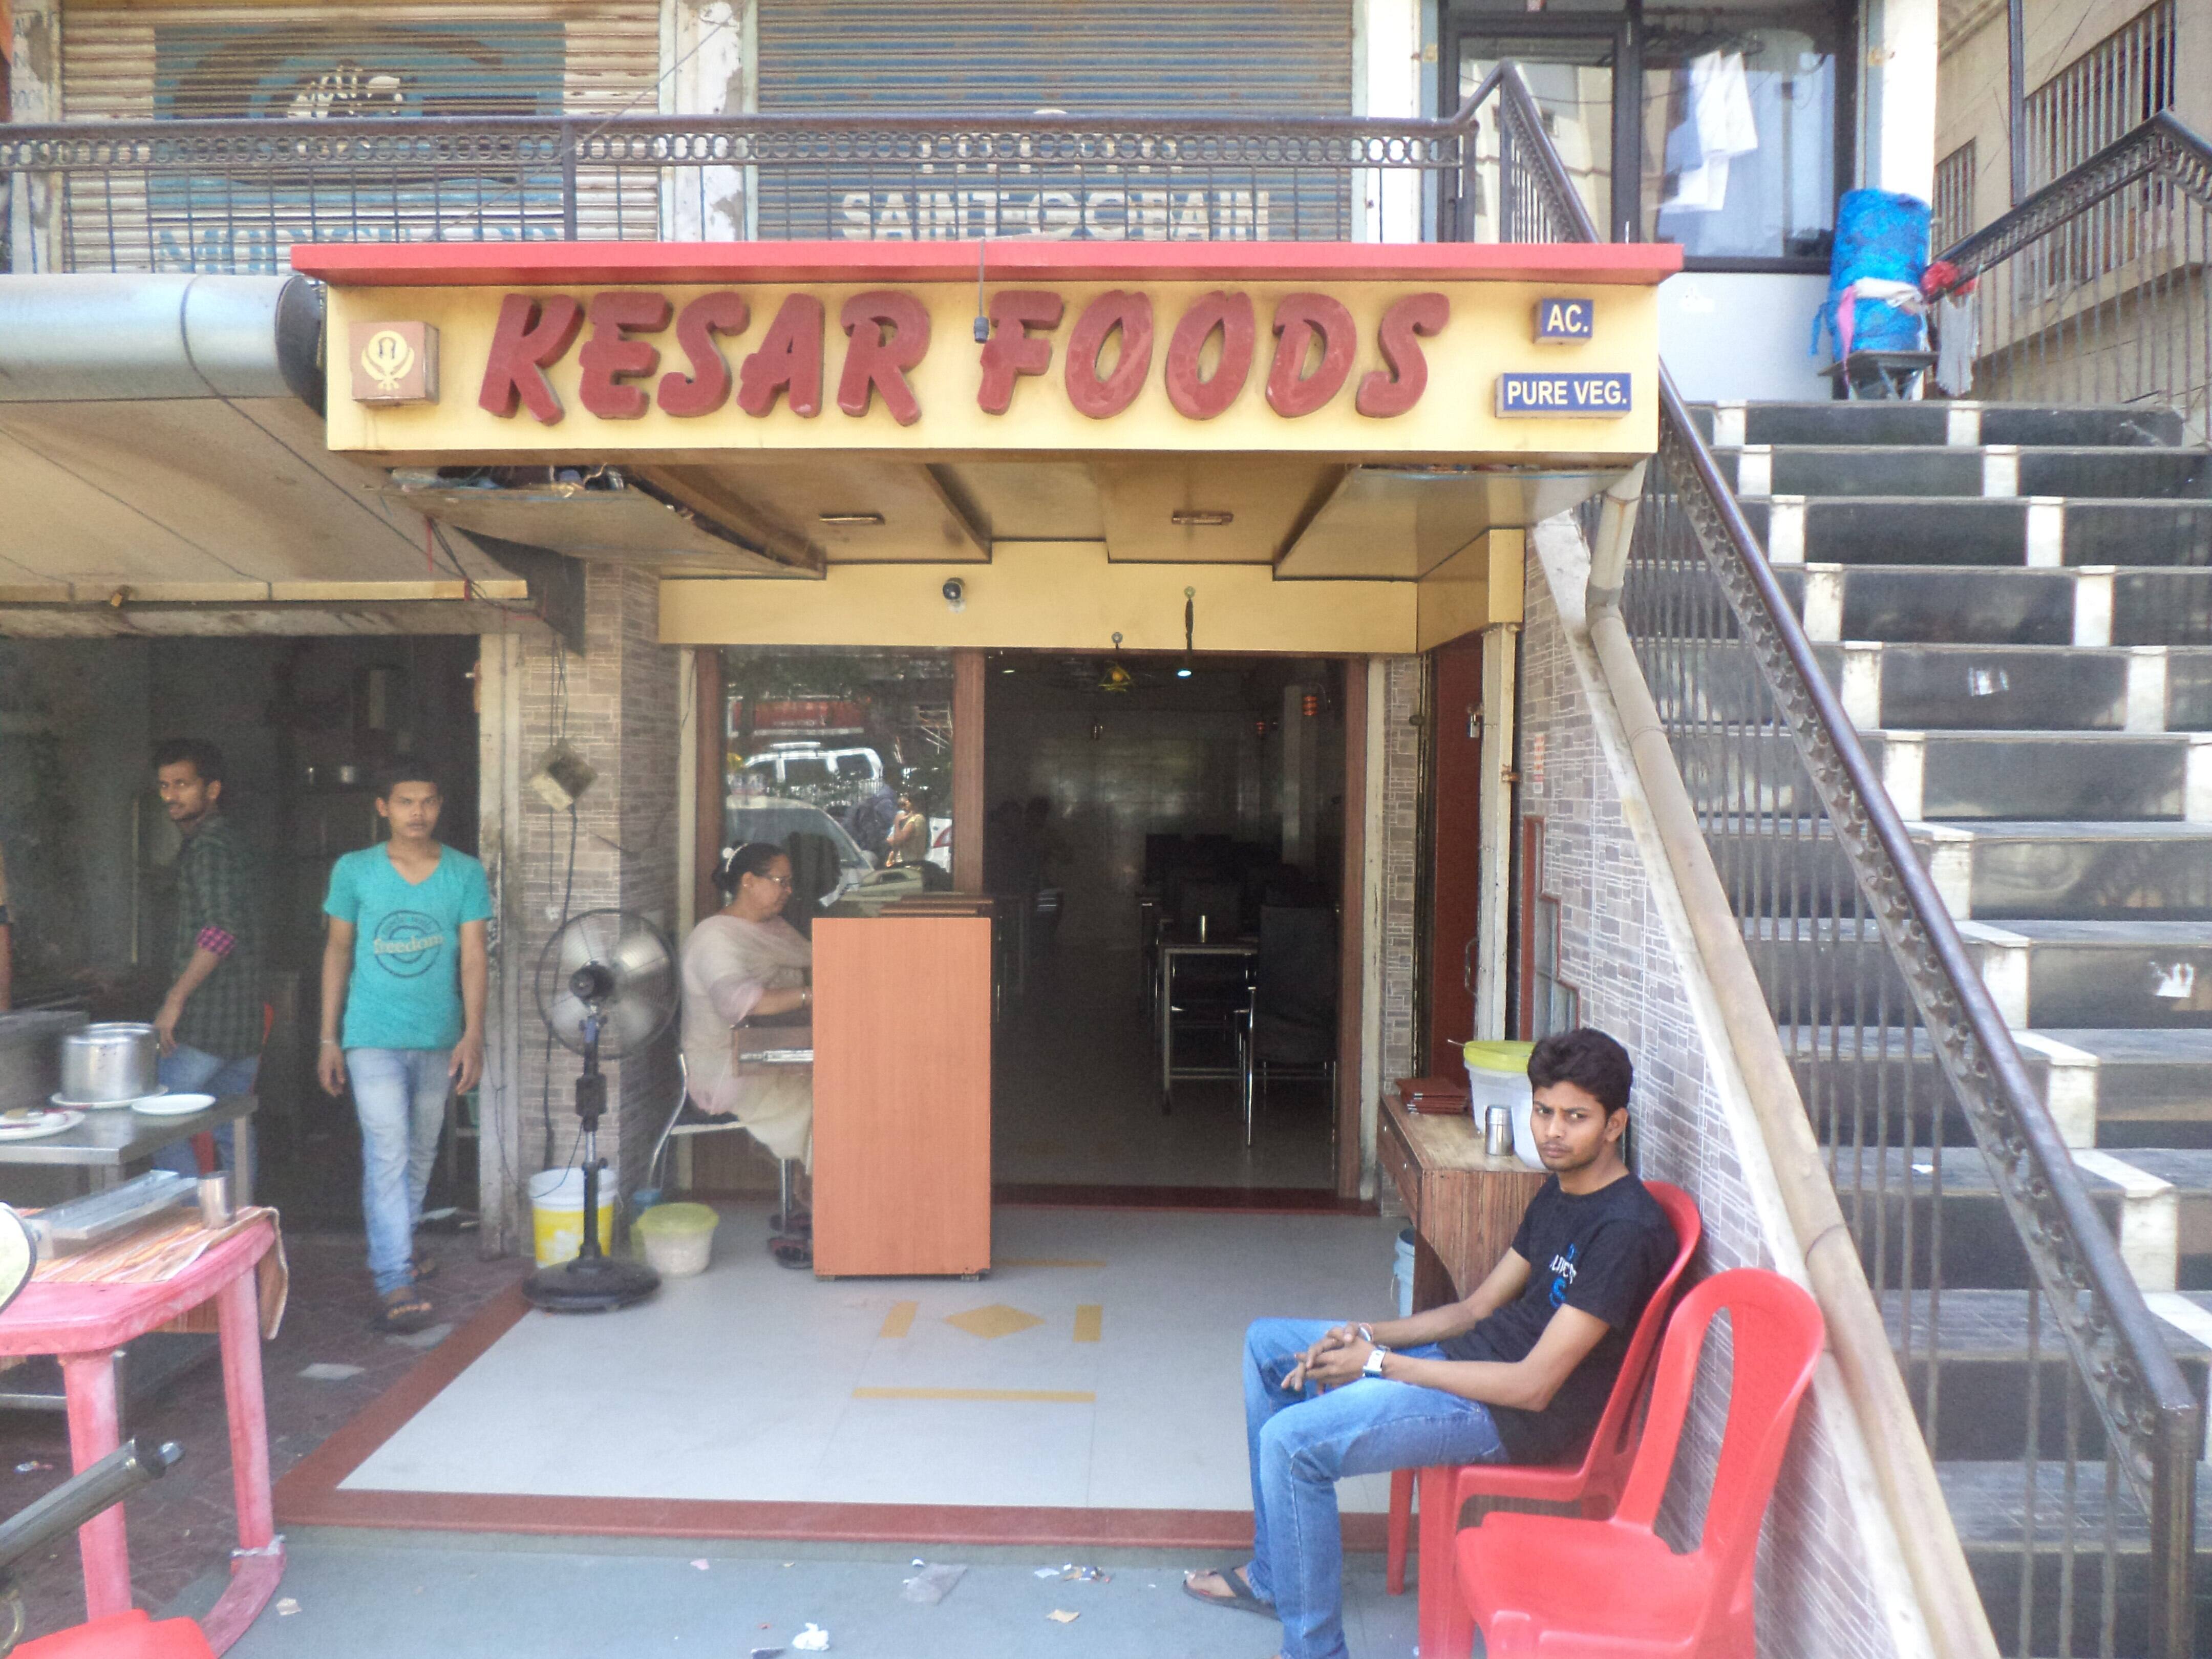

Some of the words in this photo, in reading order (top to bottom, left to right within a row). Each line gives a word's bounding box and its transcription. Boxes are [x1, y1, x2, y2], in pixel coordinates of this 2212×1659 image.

[478, 290, 931, 427] KESAR
[976, 289, 1450, 420] FOODS
[1507, 380, 1568, 405] PURE
[1574, 379, 1627, 405] VEG.
